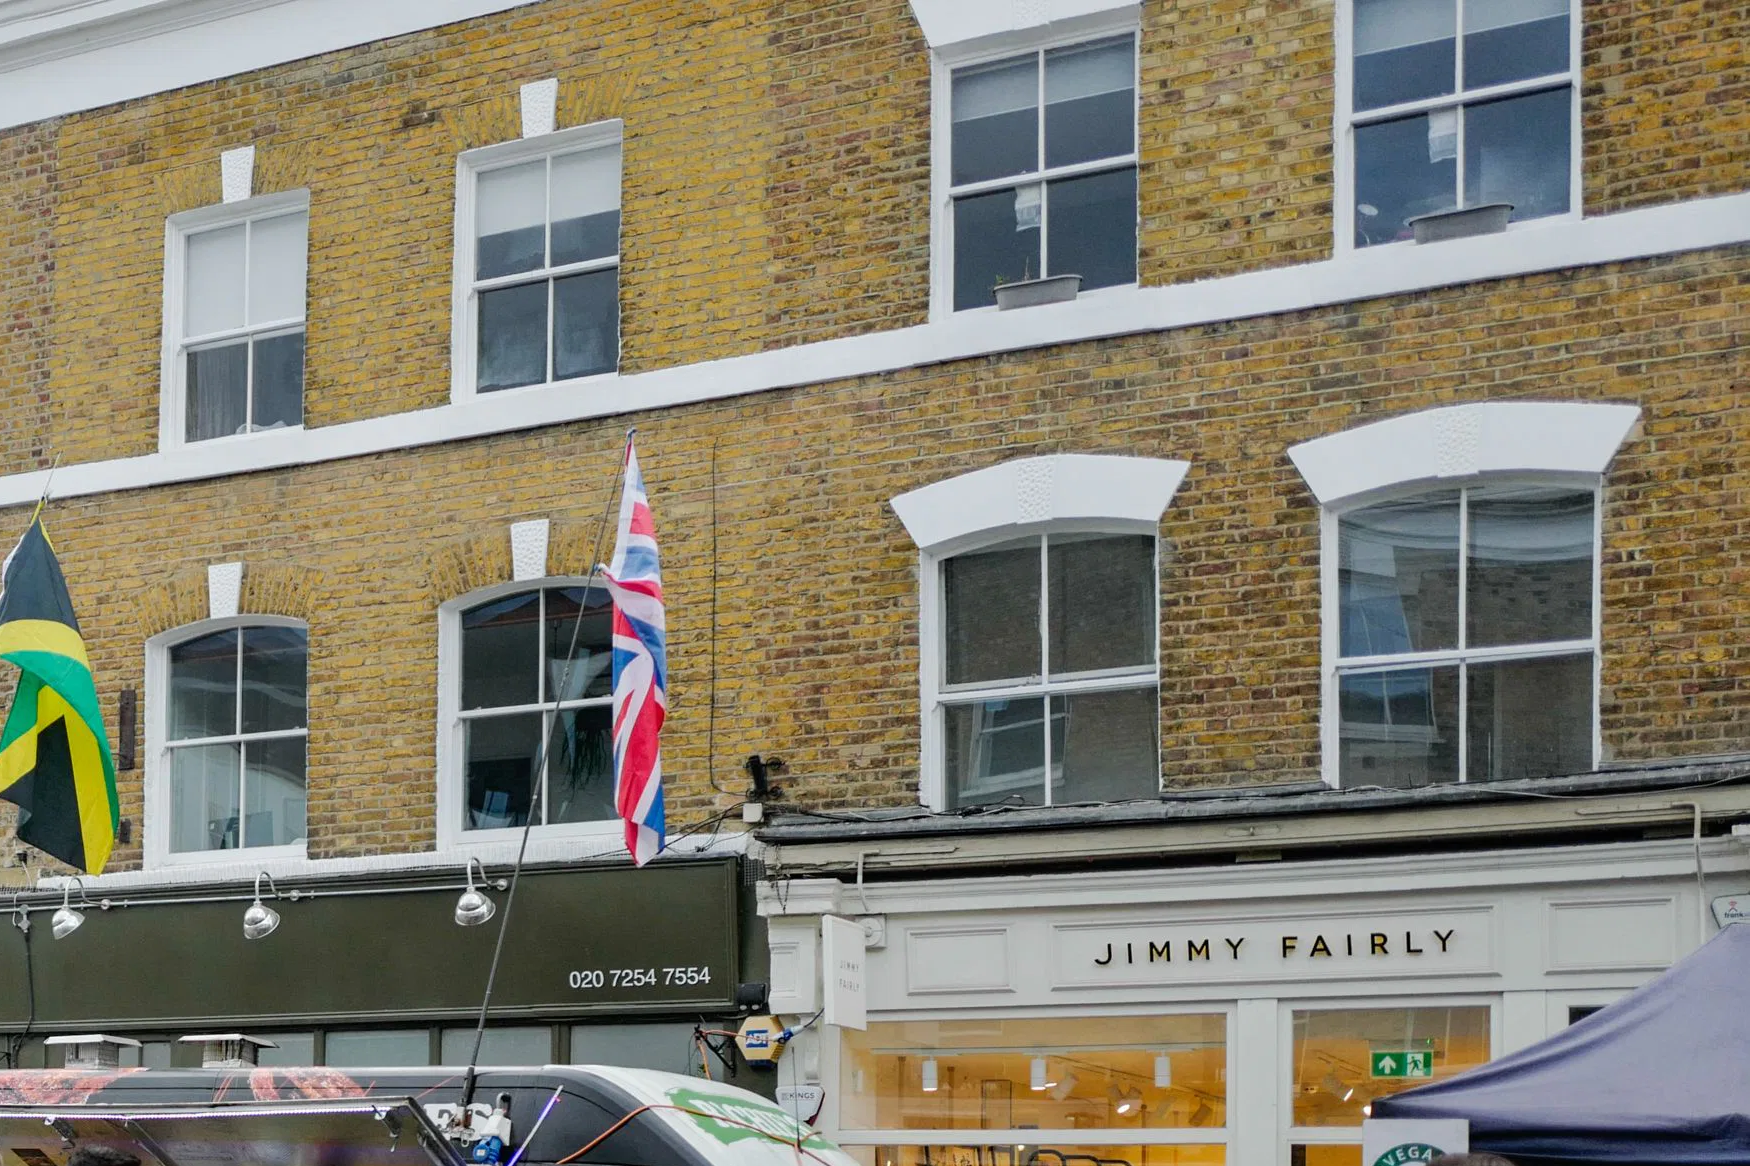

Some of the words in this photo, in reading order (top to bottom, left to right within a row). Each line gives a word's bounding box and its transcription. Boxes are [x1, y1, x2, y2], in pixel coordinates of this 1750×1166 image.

[1094, 937, 1245, 966] JIMMY
[1281, 929, 1455, 959] FAIRLY
[569, 971, 605, 989] 020
[609, 968, 657, 987] 7254
[662, 966, 712, 985] 7554
